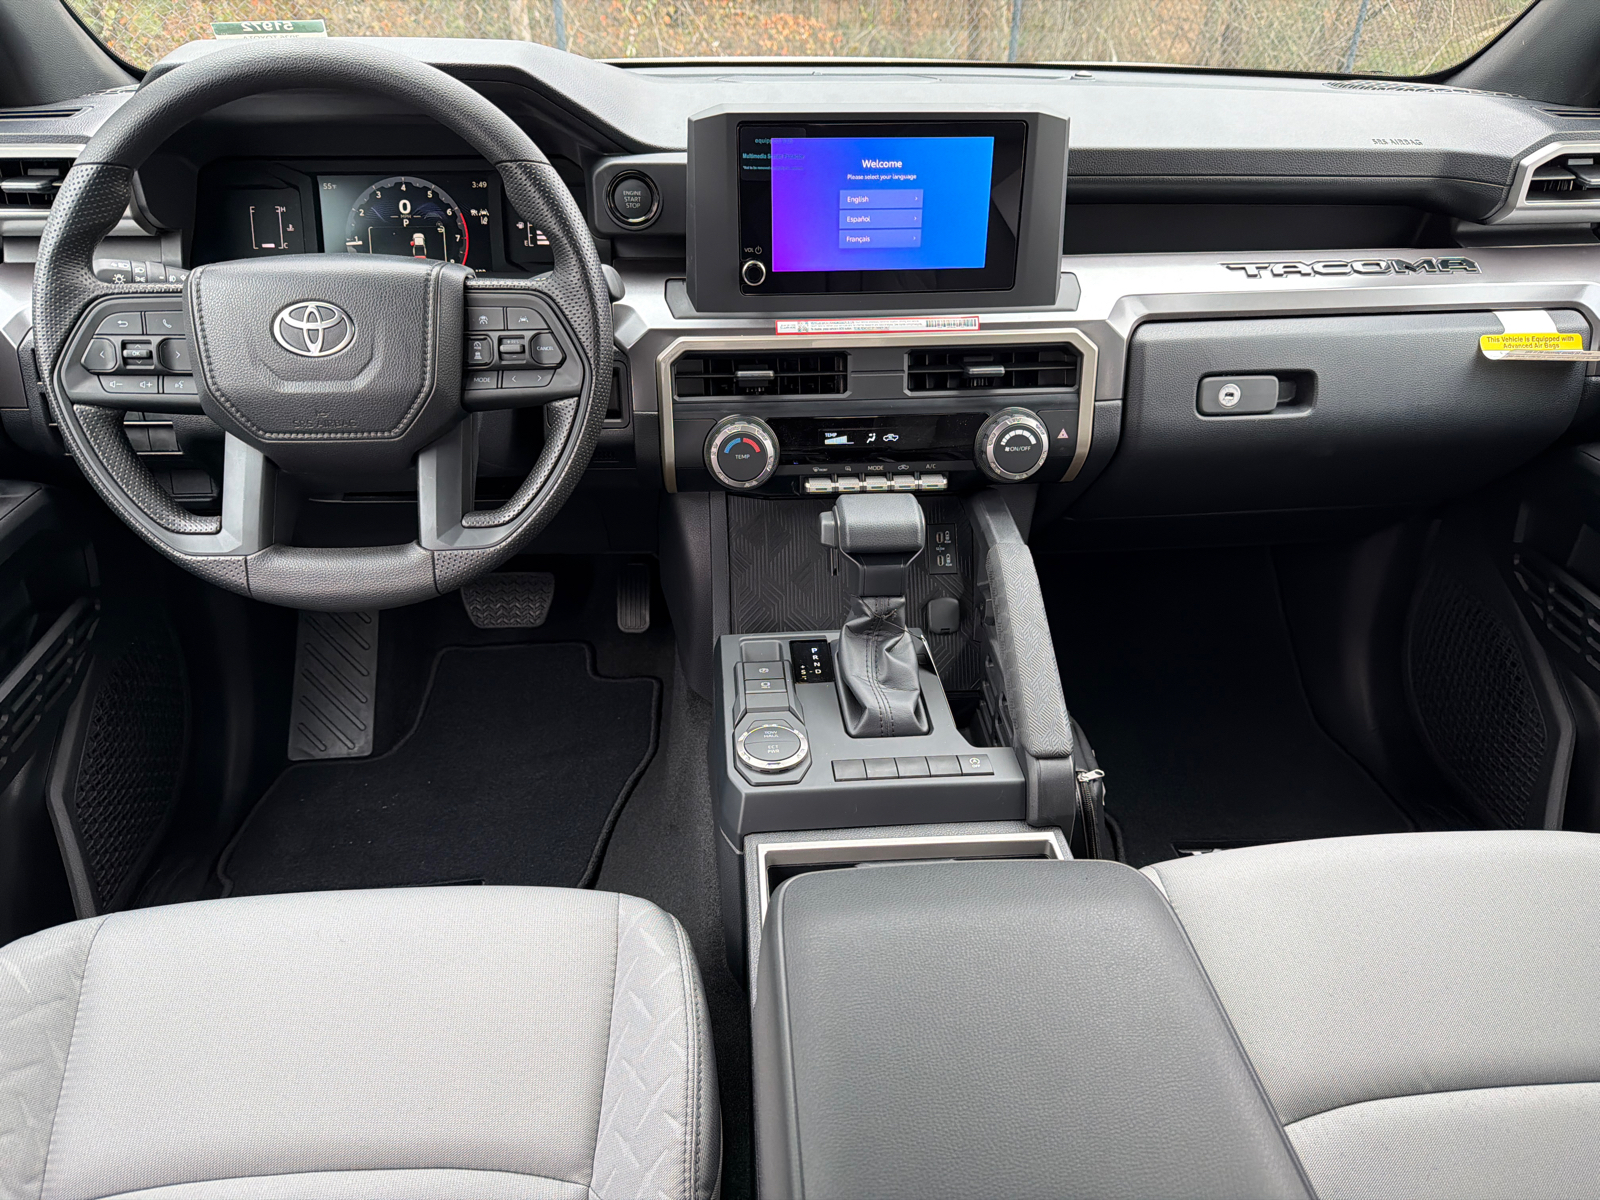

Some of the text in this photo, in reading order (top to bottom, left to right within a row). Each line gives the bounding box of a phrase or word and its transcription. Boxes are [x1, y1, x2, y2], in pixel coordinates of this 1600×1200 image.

[862, 158, 902, 168] Welcome
[376, 190, 382, 198] 3
[846, 196, 869, 204] English
[398, 200, 411, 214] 0
[359, 208, 364, 216] 2
[403, 219, 410, 227] P
[1218, 256, 1482, 279] TACOMA
